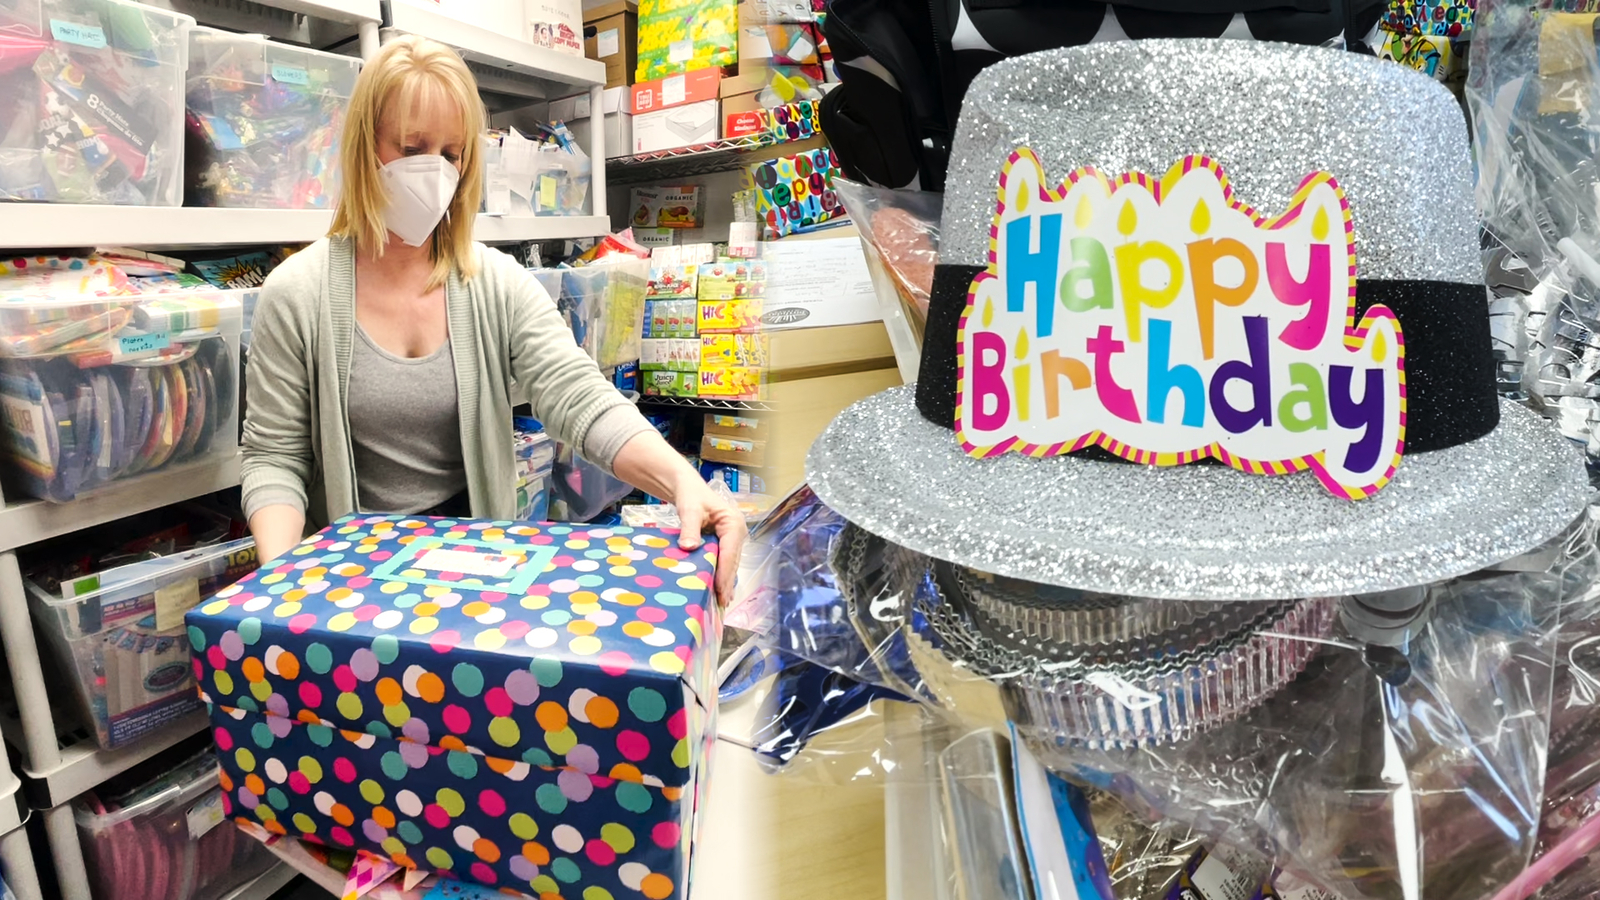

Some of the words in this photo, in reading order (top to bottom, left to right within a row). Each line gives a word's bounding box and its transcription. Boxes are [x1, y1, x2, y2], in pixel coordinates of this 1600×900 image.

[87, 93, 99, 109] 8
[1006, 213, 1331, 361] Happy
[972, 316, 1384, 474] Birthday
[228, 547, 257, 567] TOY
